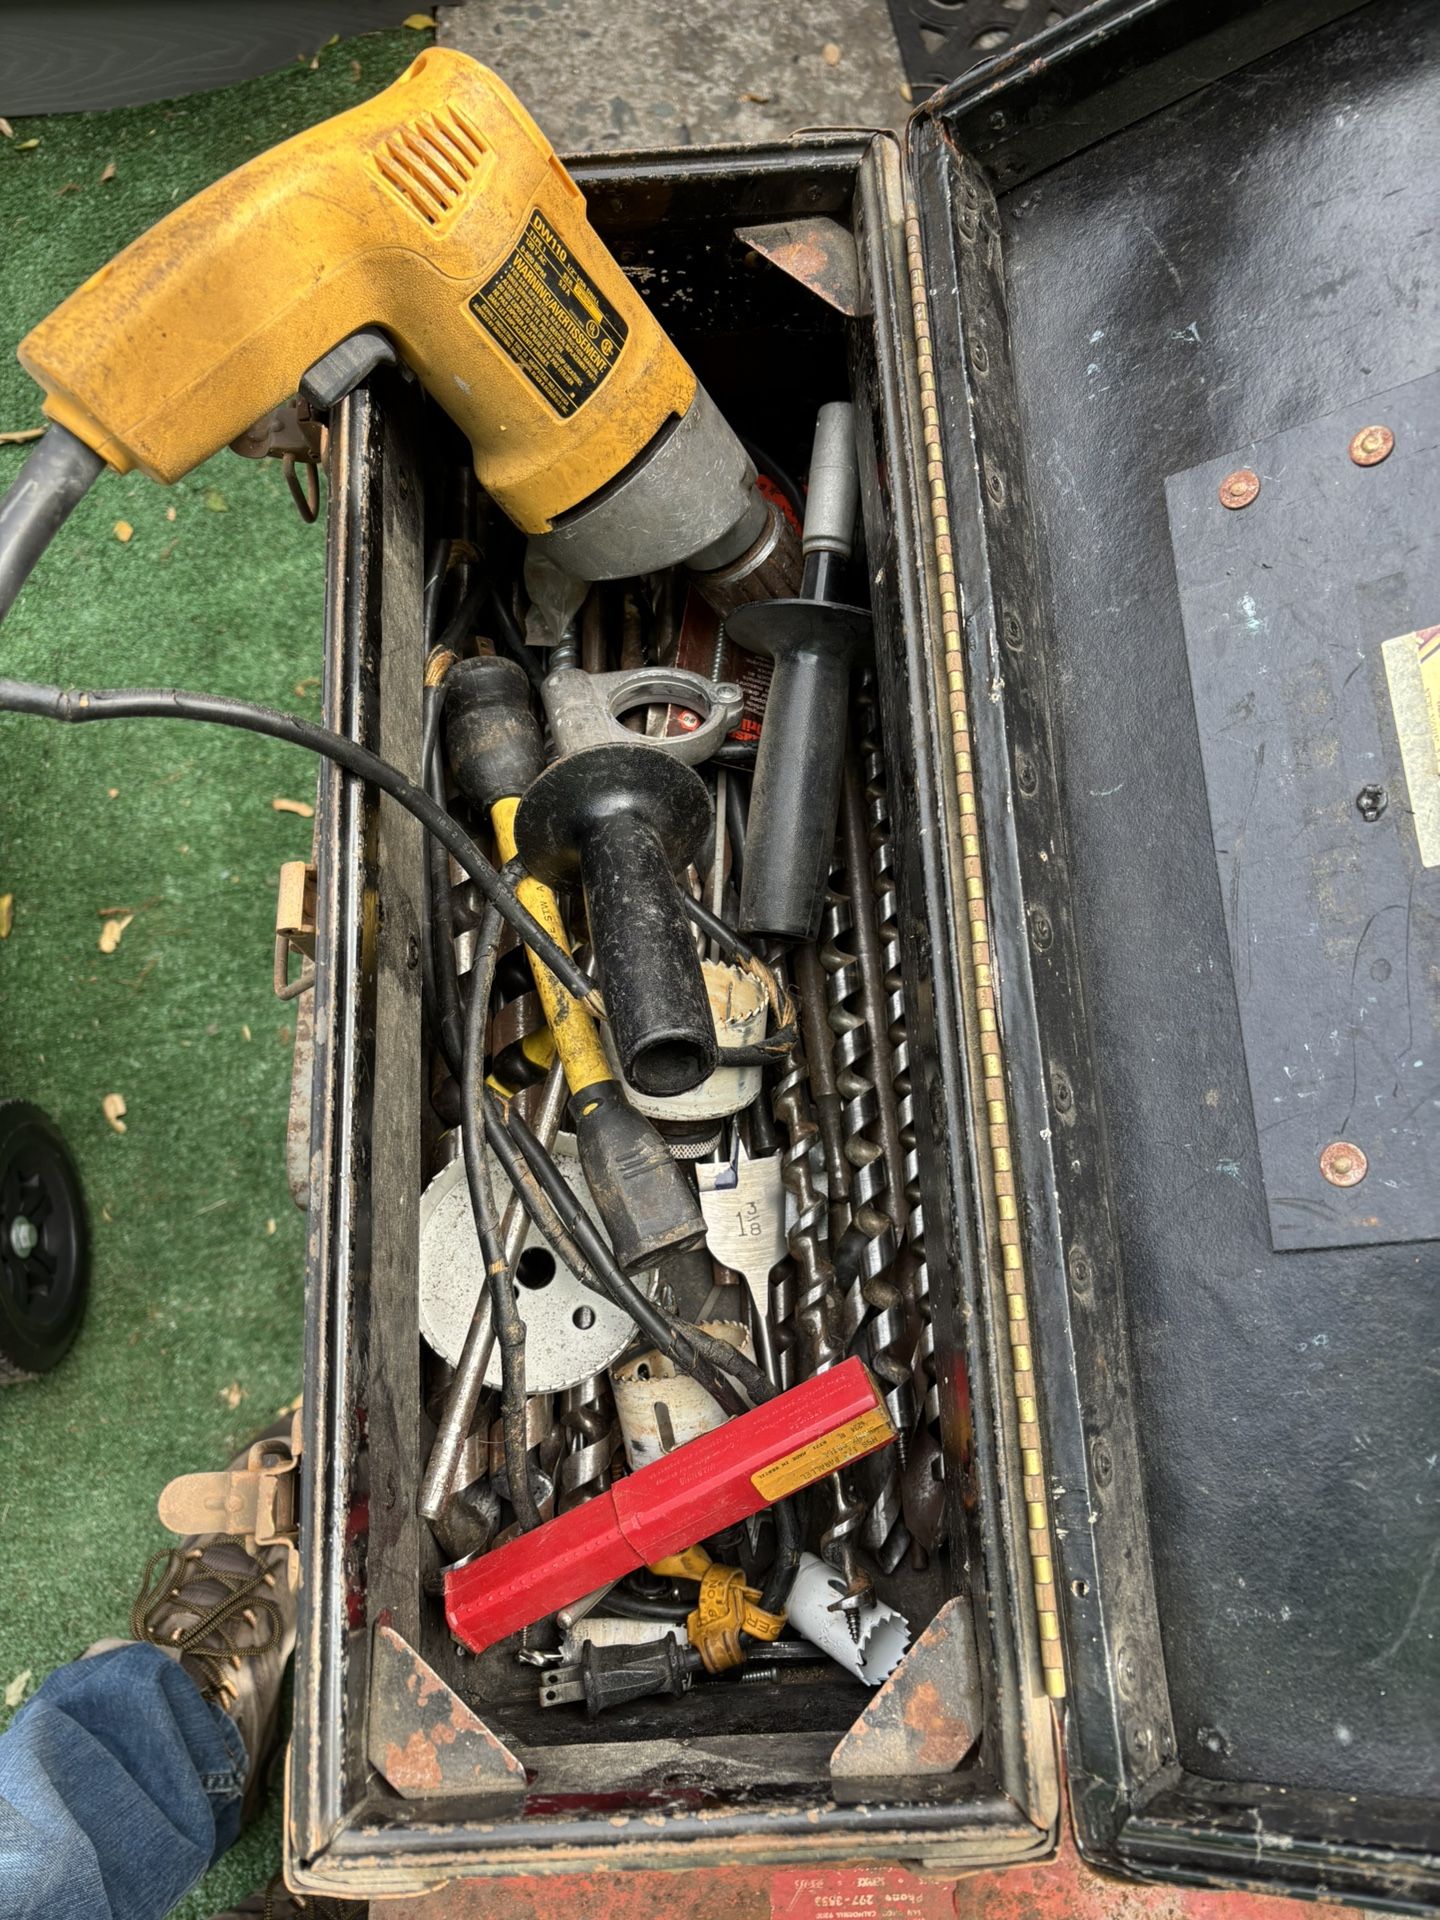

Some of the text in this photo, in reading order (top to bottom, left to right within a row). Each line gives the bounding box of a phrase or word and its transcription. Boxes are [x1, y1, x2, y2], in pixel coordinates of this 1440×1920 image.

[525, 236, 535, 251] 120
[532, 214, 567, 263] DW110
[532, 260, 546, 279] RPM
[502, 277, 521, 301] ALWAYS
[519, 298, 533, 316] WEAR
[798, 1455, 840, 1482] PARALLEL
[884, 1892, 923, 1905] Phone
